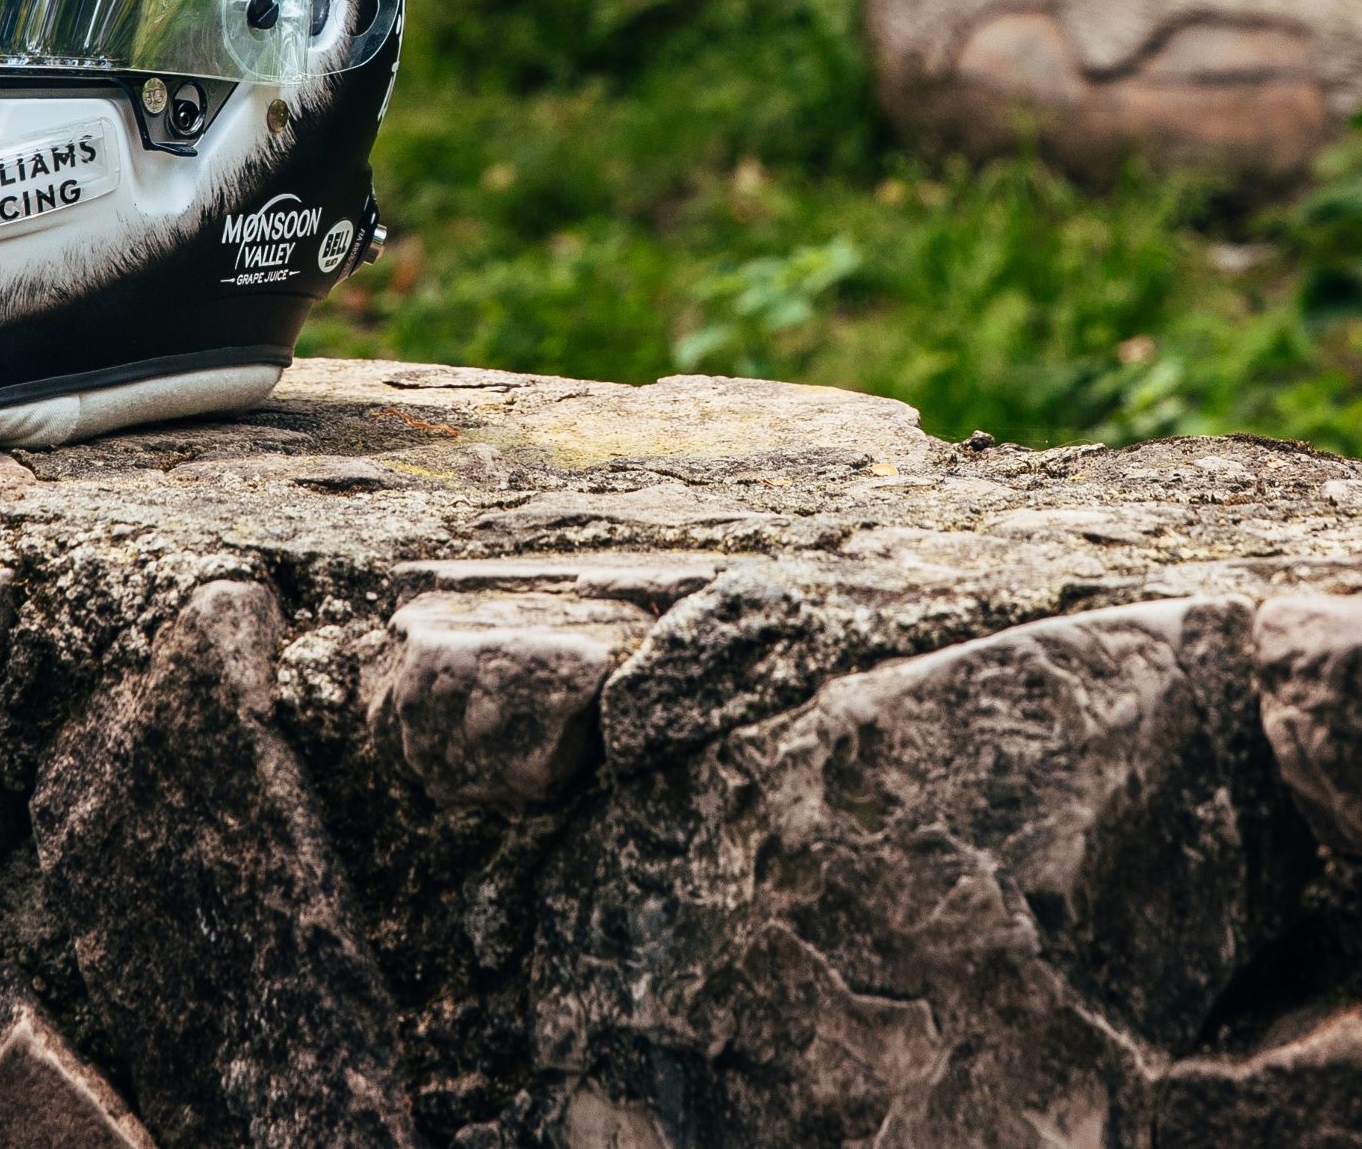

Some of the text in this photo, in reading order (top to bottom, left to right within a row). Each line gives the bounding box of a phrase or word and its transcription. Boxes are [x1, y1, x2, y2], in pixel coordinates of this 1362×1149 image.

[244, 242, 297, 268] VALLEY
[322, 230, 350, 258] BELL
[237, 269, 289, 285] GRAPE JUICE
